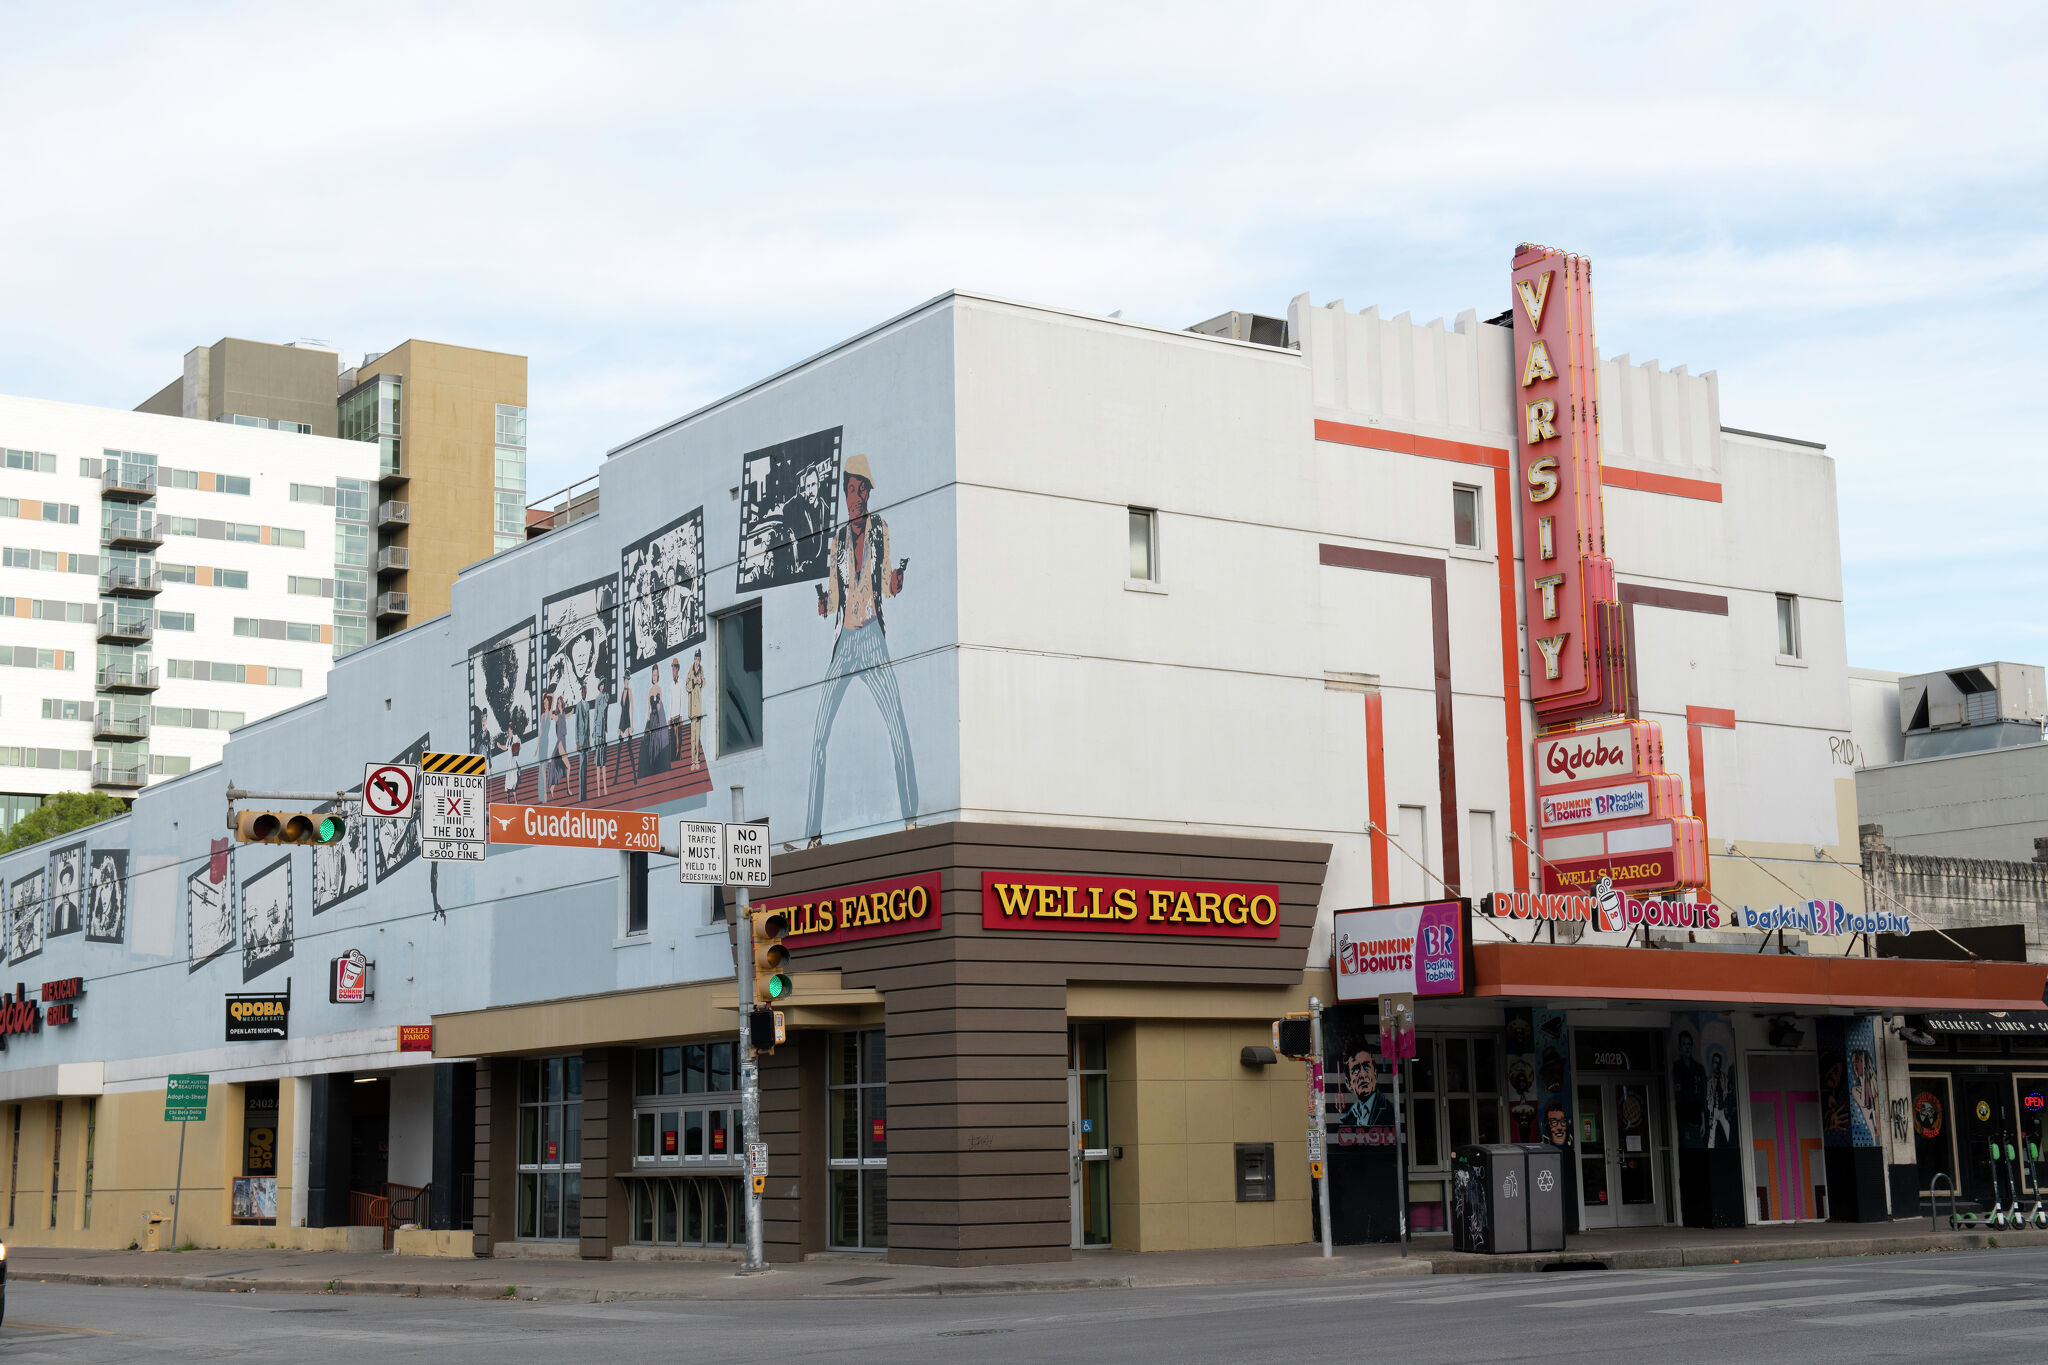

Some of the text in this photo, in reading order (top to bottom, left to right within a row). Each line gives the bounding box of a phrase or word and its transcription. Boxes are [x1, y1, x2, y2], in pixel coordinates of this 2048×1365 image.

[1516, 270, 1570, 681] VARSITY
[1547, 736, 1624, 780] Qdoba
[454, 777, 483, 789] BLOCK
[1556, 798, 1593, 810] DUNKIN'
[1595, 794, 1615, 814] BR
[1557, 808, 1592, 820] DONUTS
[433, 826, 475, 838] THE BOX
[524, 807, 657, 846] Guadalupe ST
[687, 824, 717, 833] TURNING
[624, 832, 658, 848] 2400
[687, 835, 716, 844] TRAFFIC
[738, 829, 757, 841] NO
[439, 842, 469, 851] UP TO
[733, 844, 762, 854] RIGHT
[429, 850, 479, 860] $500 FINE
[688, 847, 716, 859] MUST
[685, 862, 717, 871] YIELD TO
[736, 857, 762, 868] TURN
[681, 873, 722, 881] PEDESTRIANS
[729, 871, 767, 881] ON RED
[1556, 862, 1662, 886] WELLS FARGO
[993, 883, 1278, 925] WELLS FARGO
[1493, 891, 1597, 921] DUNKIN'
[1627, 899, 1720, 929] DONUTS
[768, 885, 927, 936] LLS FARGO
[1744, 899, 1909, 936] baskin BR robbins
[1359, 936, 1414, 957] DUNKIN'
[1423, 925, 1454, 956] BR
[1359, 954, 1413, 973] DONUTS
[1425, 958, 1453, 971] baskin
[1425, 970, 1455, 982] robbins
[42, 977, 78, 1002] MEXICAN
[0, 983, 36, 1035] doba
[47, 1004, 70, 1026] GRILL
[231, 1001, 284, 1021] QDOBA
[1929, 1020, 1984, 1031] BREAKFAST
[1995, 1021, 2028, 1031] LUNCH
[1594, 1052, 1623, 1065] 2402B
[249, 1098, 273, 1109] 2402
[2024, 1096, 2045, 1107] OPEN
